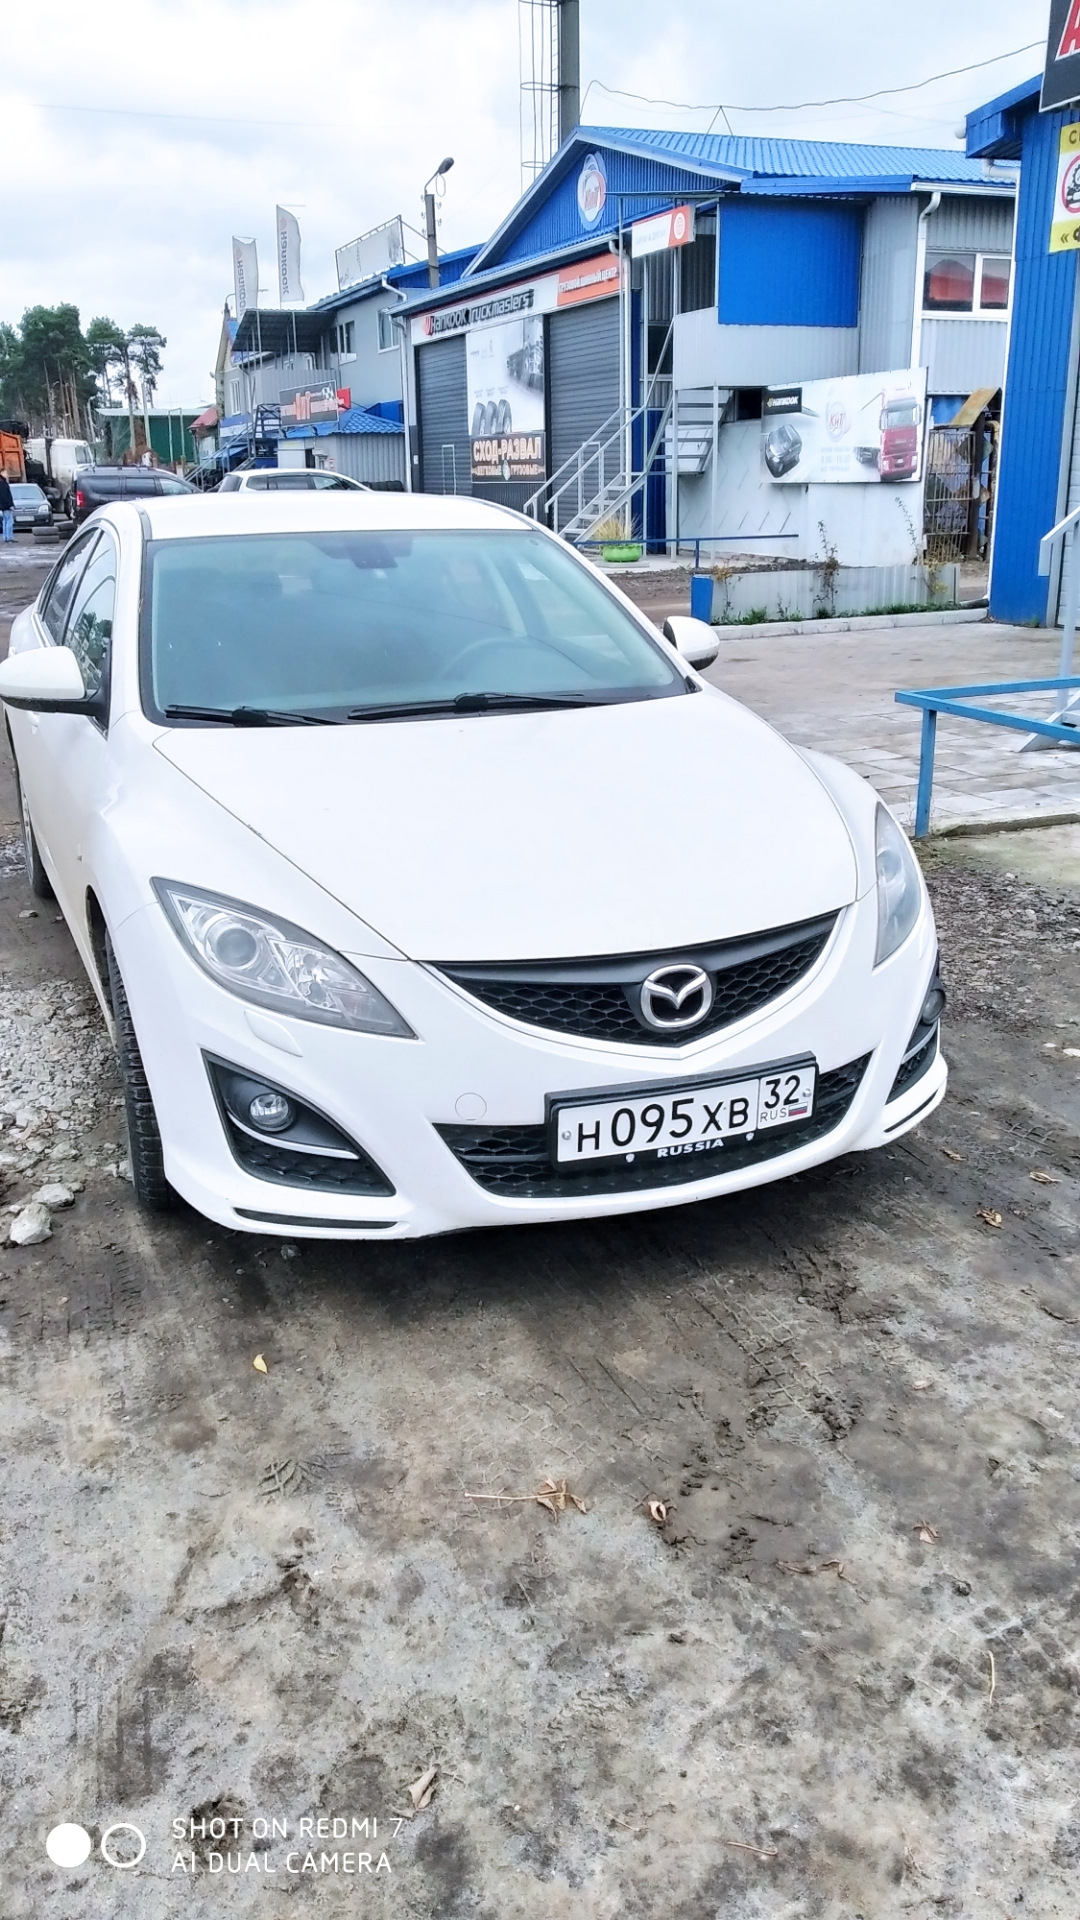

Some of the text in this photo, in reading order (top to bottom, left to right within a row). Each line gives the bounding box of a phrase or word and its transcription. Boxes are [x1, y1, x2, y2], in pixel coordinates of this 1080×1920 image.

[473, 437, 541, 464] СХОД-РАЗВАЛ
[764, 1074, 801, 1109] 32
[759, 1108, 788, 1123] RUS
[656, 1138, 725, 1158] RUSSIA
